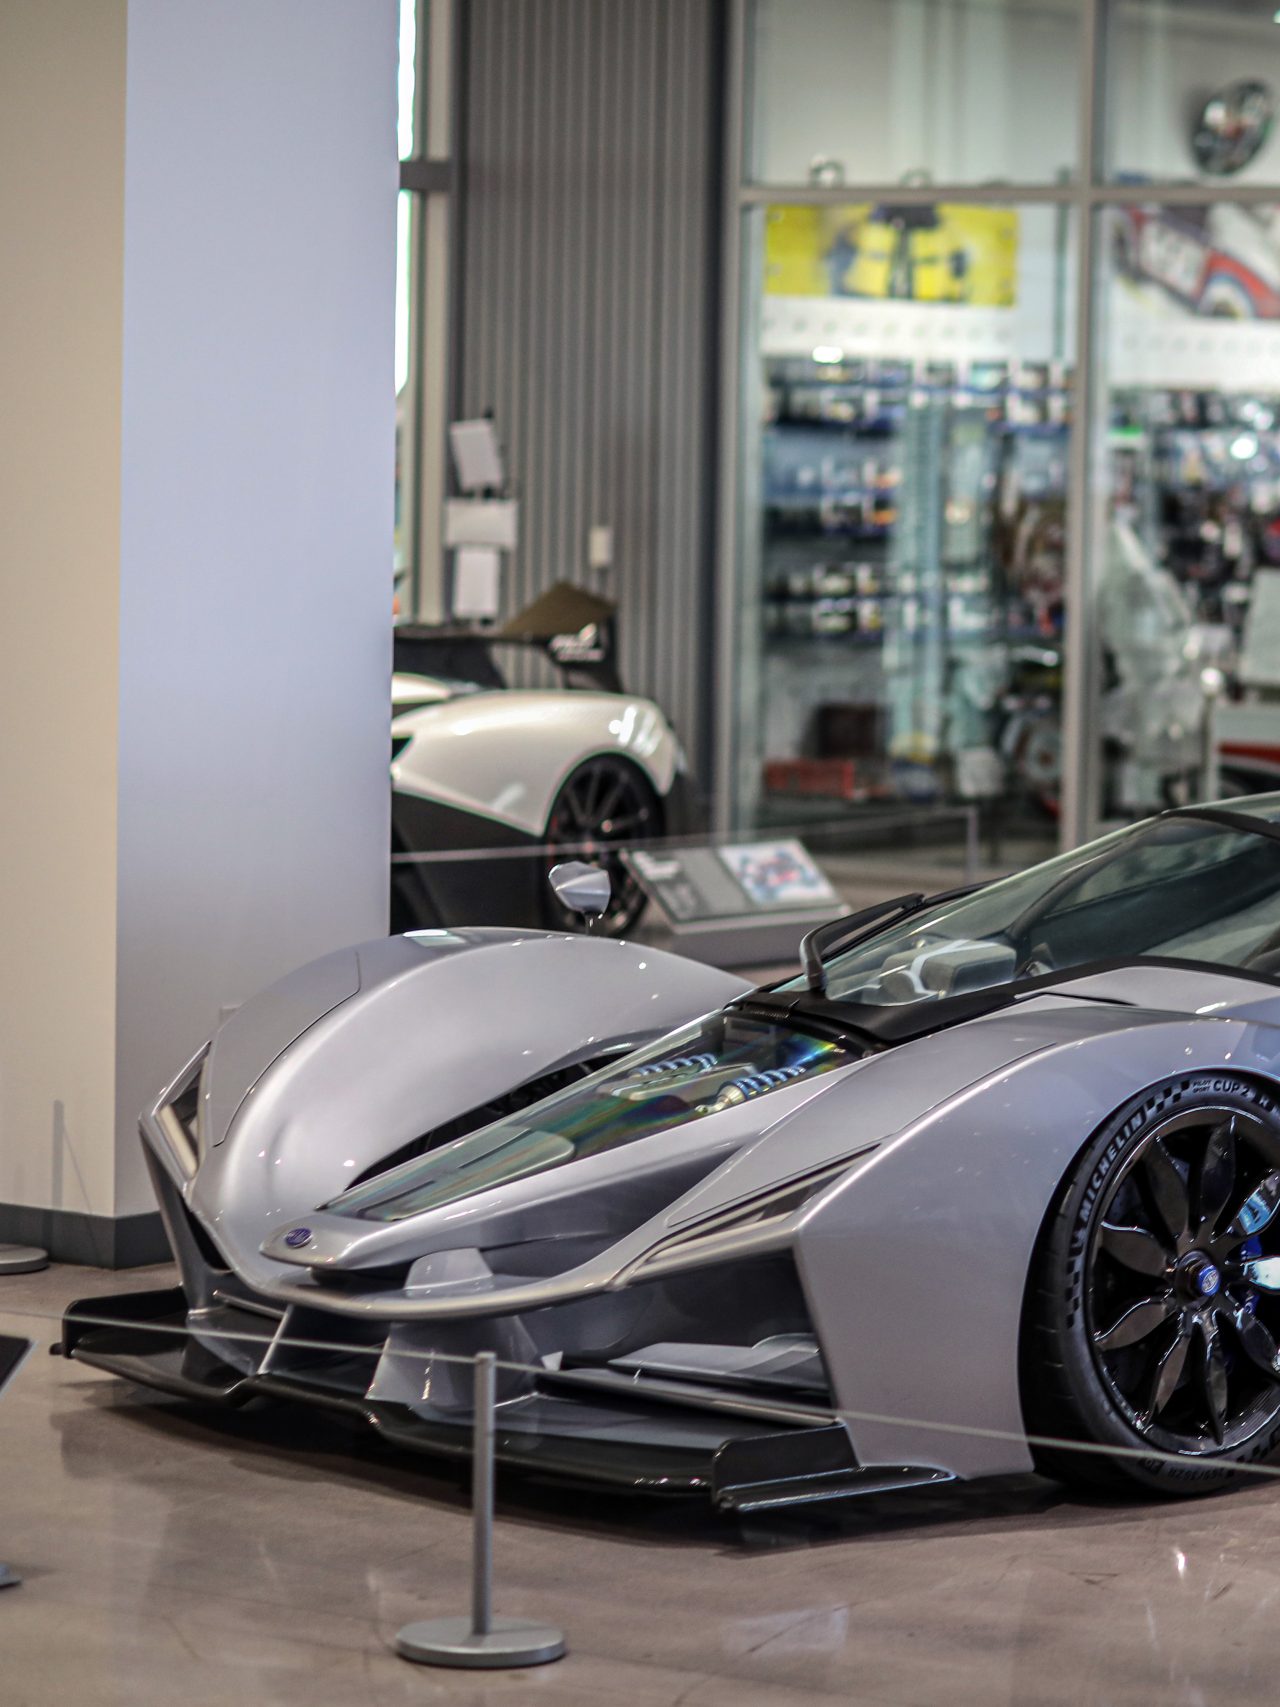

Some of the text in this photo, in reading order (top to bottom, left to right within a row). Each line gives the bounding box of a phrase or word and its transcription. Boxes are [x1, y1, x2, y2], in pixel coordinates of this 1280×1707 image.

[1213, 1080, 1239, 1093] CUP
[1240, 1085, 1250, 1097] 2
[1079, 1107, 1145, 1222] MICHELIN
